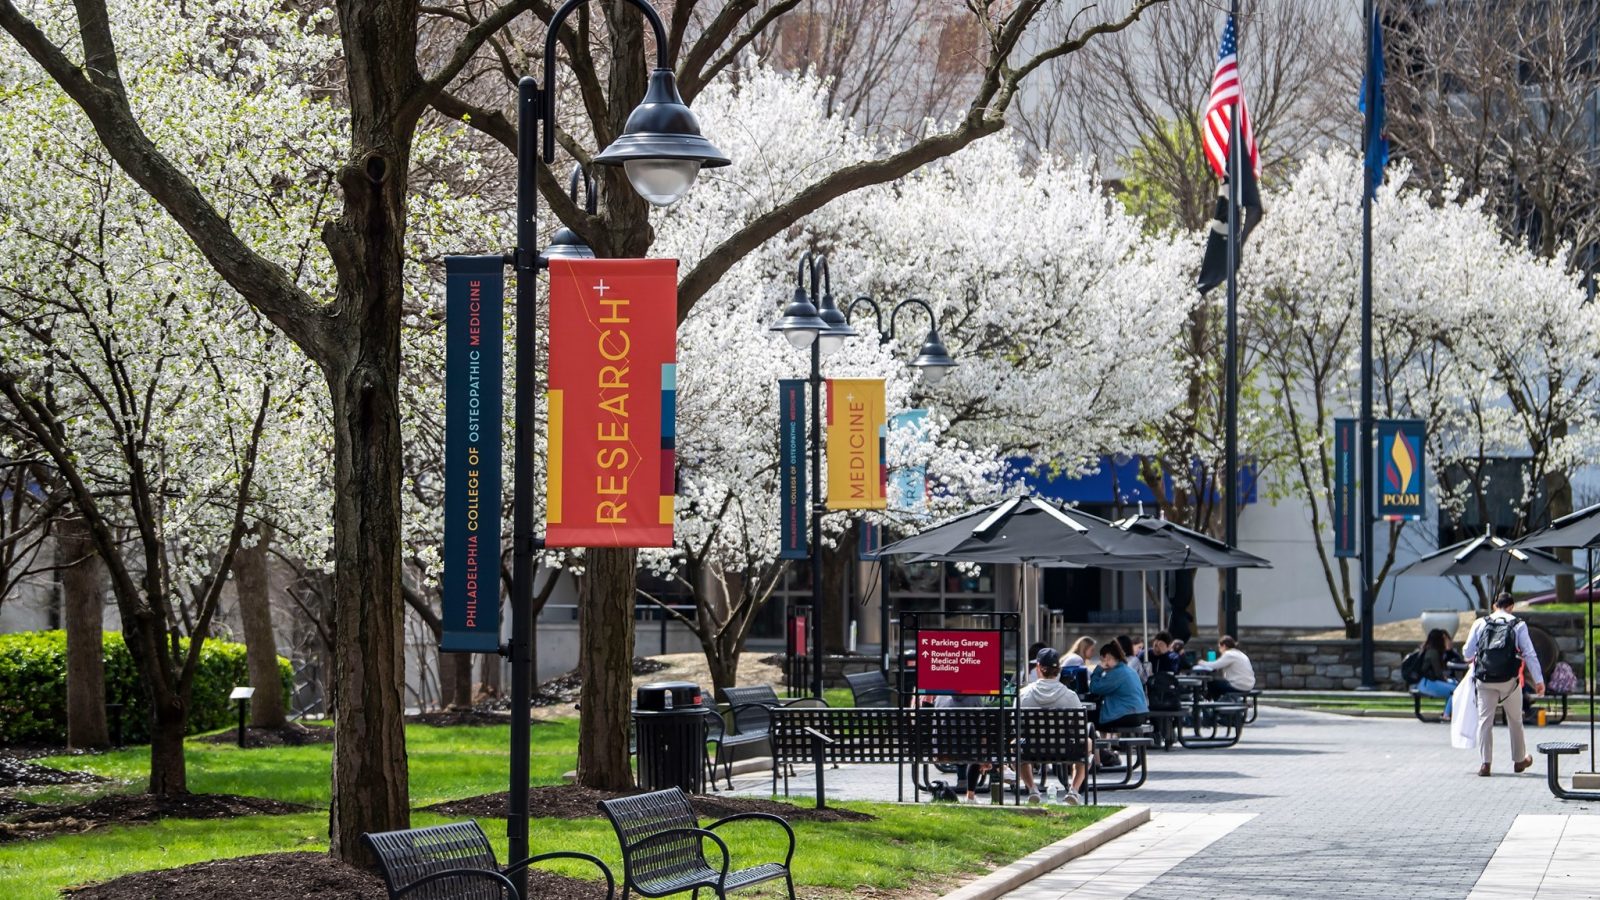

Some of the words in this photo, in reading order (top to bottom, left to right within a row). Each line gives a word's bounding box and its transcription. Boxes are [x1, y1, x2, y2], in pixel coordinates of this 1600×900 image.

[469, 280, 480, 347] MEDICINE
[469, 350, 480, 442] OSTEOPATHIC
[468, 446, 480, 466] OF
[467, 470, 479, 532] COLLEGE
[1383, 494, 1420, 506] PCOM
[466, 535, 478, 628] PHILADELPHIA
[931, 639, 959, 648] Parking
[961, 639, 988, 648] Garage
[931, 664, 959, 673] Building
